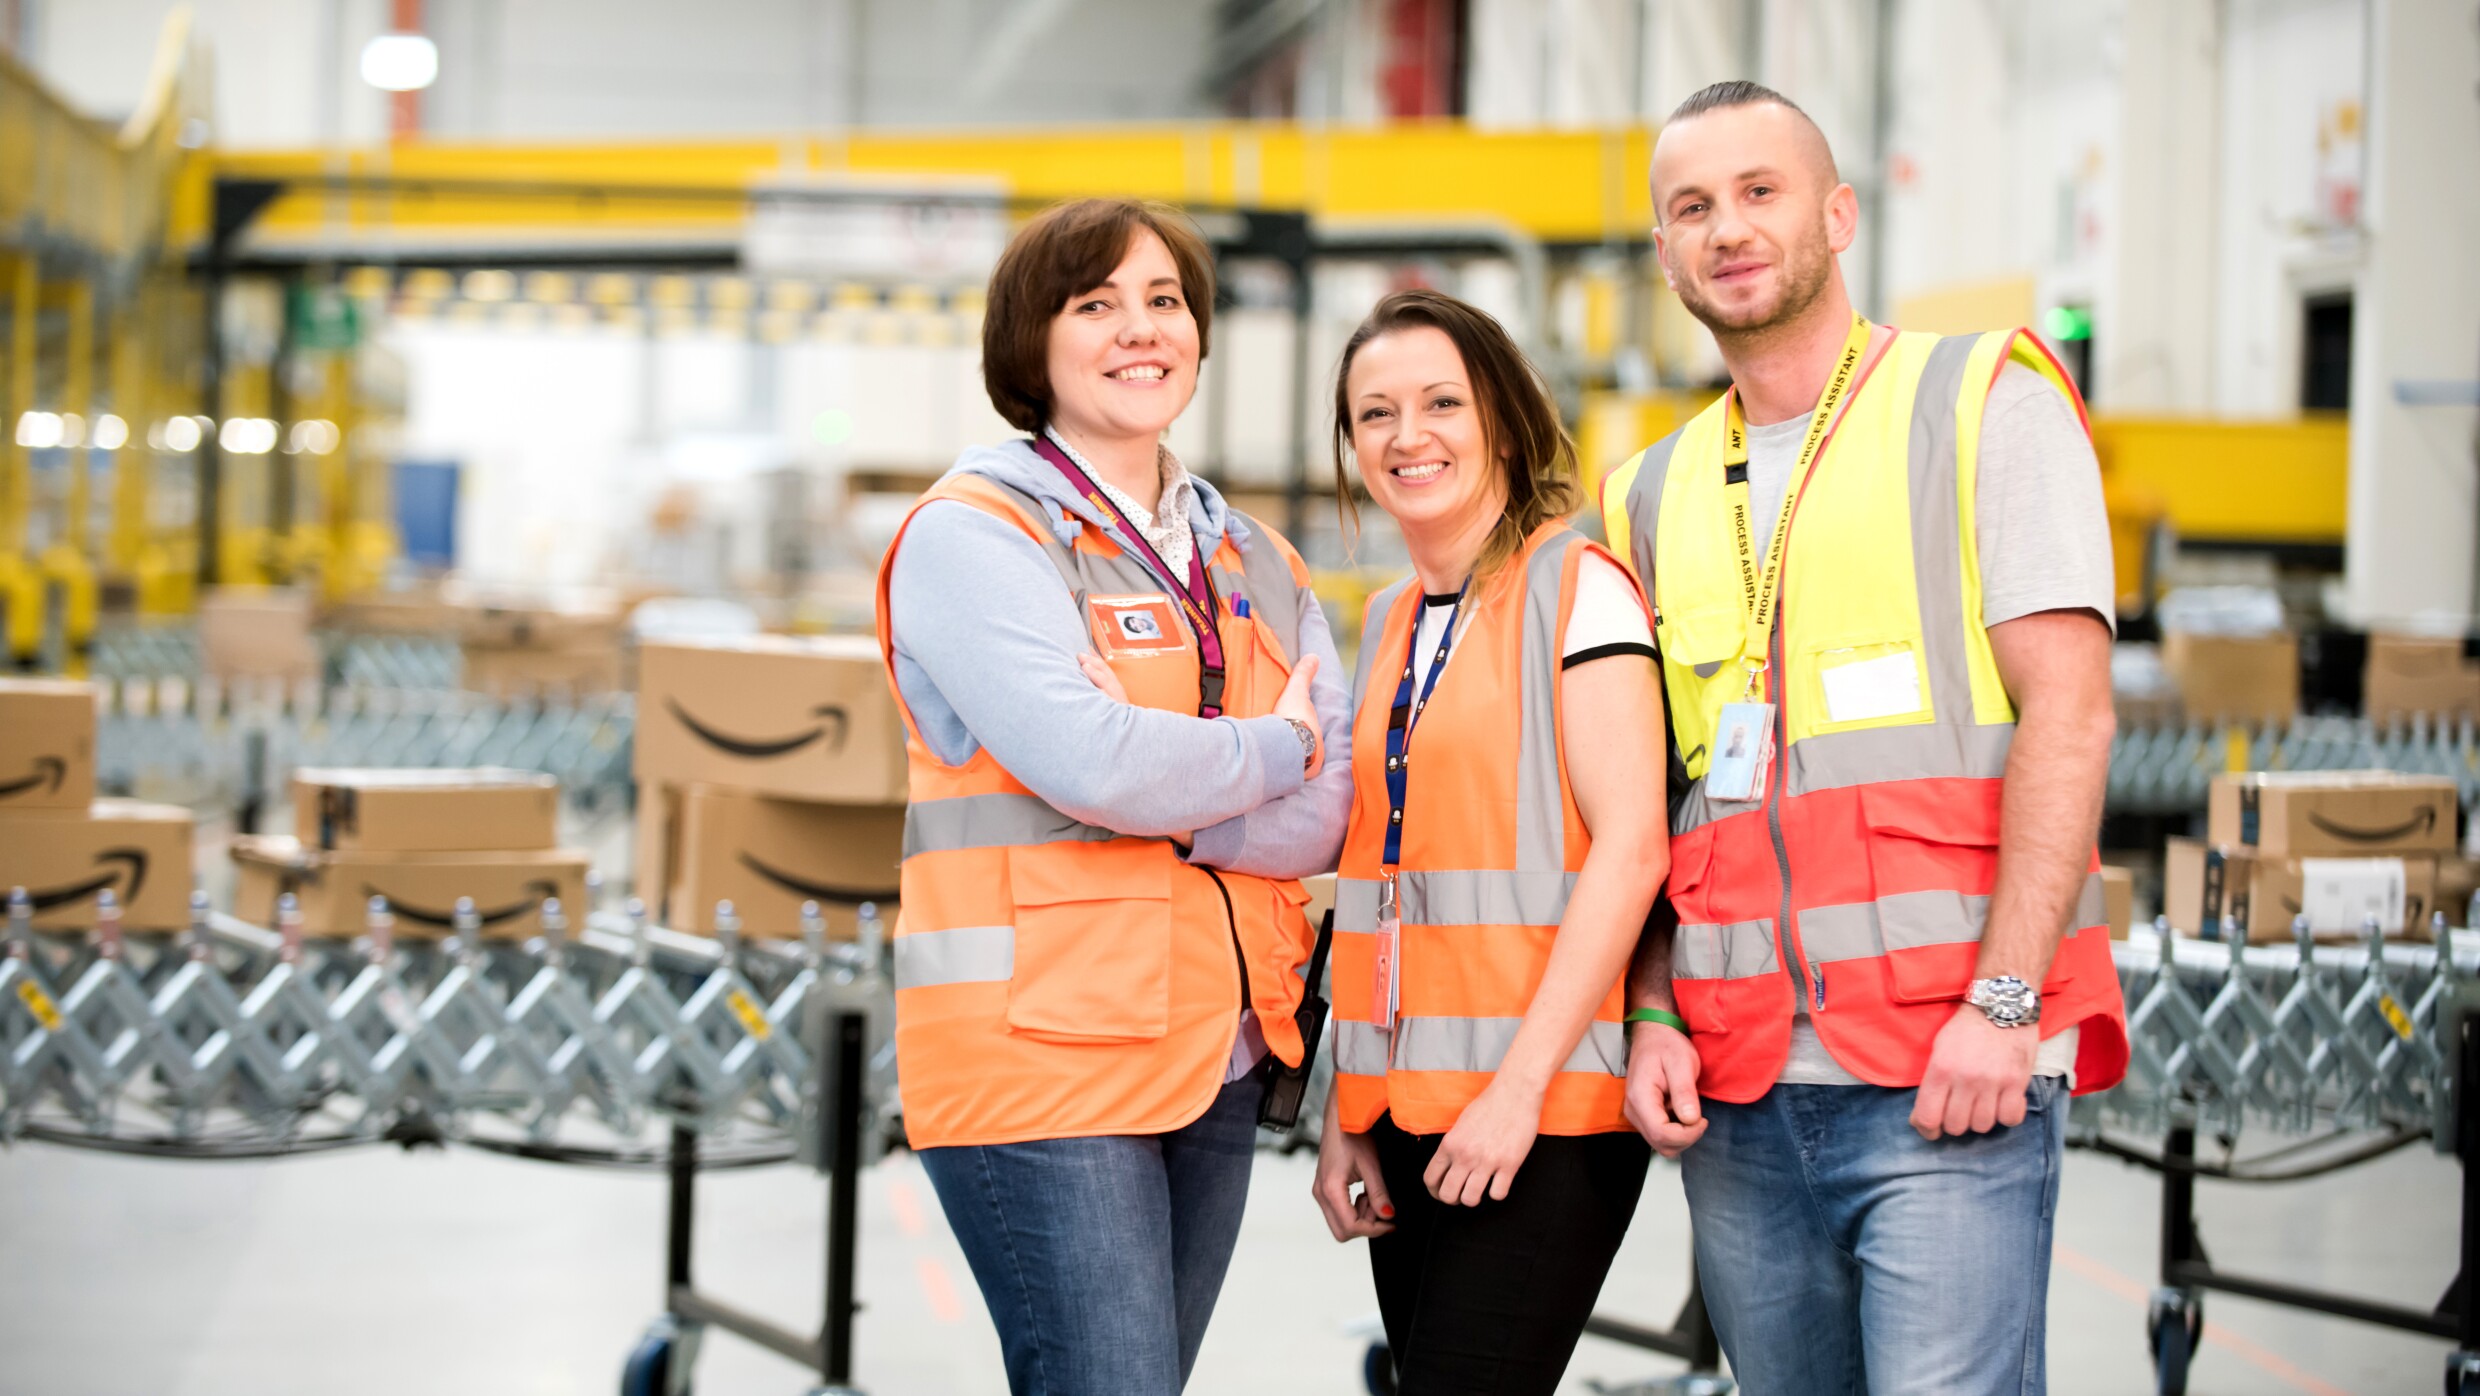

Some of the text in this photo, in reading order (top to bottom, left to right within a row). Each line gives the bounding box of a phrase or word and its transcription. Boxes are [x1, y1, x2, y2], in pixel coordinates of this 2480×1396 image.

[1800, 346, 1858, 465] PROCESS ASSISTANT
[1734, 504, 1749, 556] PROCESS
[1757, 494, 1794, 625] PROCESS ASSISTANT
[1181, 598, 1209, 636] TRAINER
